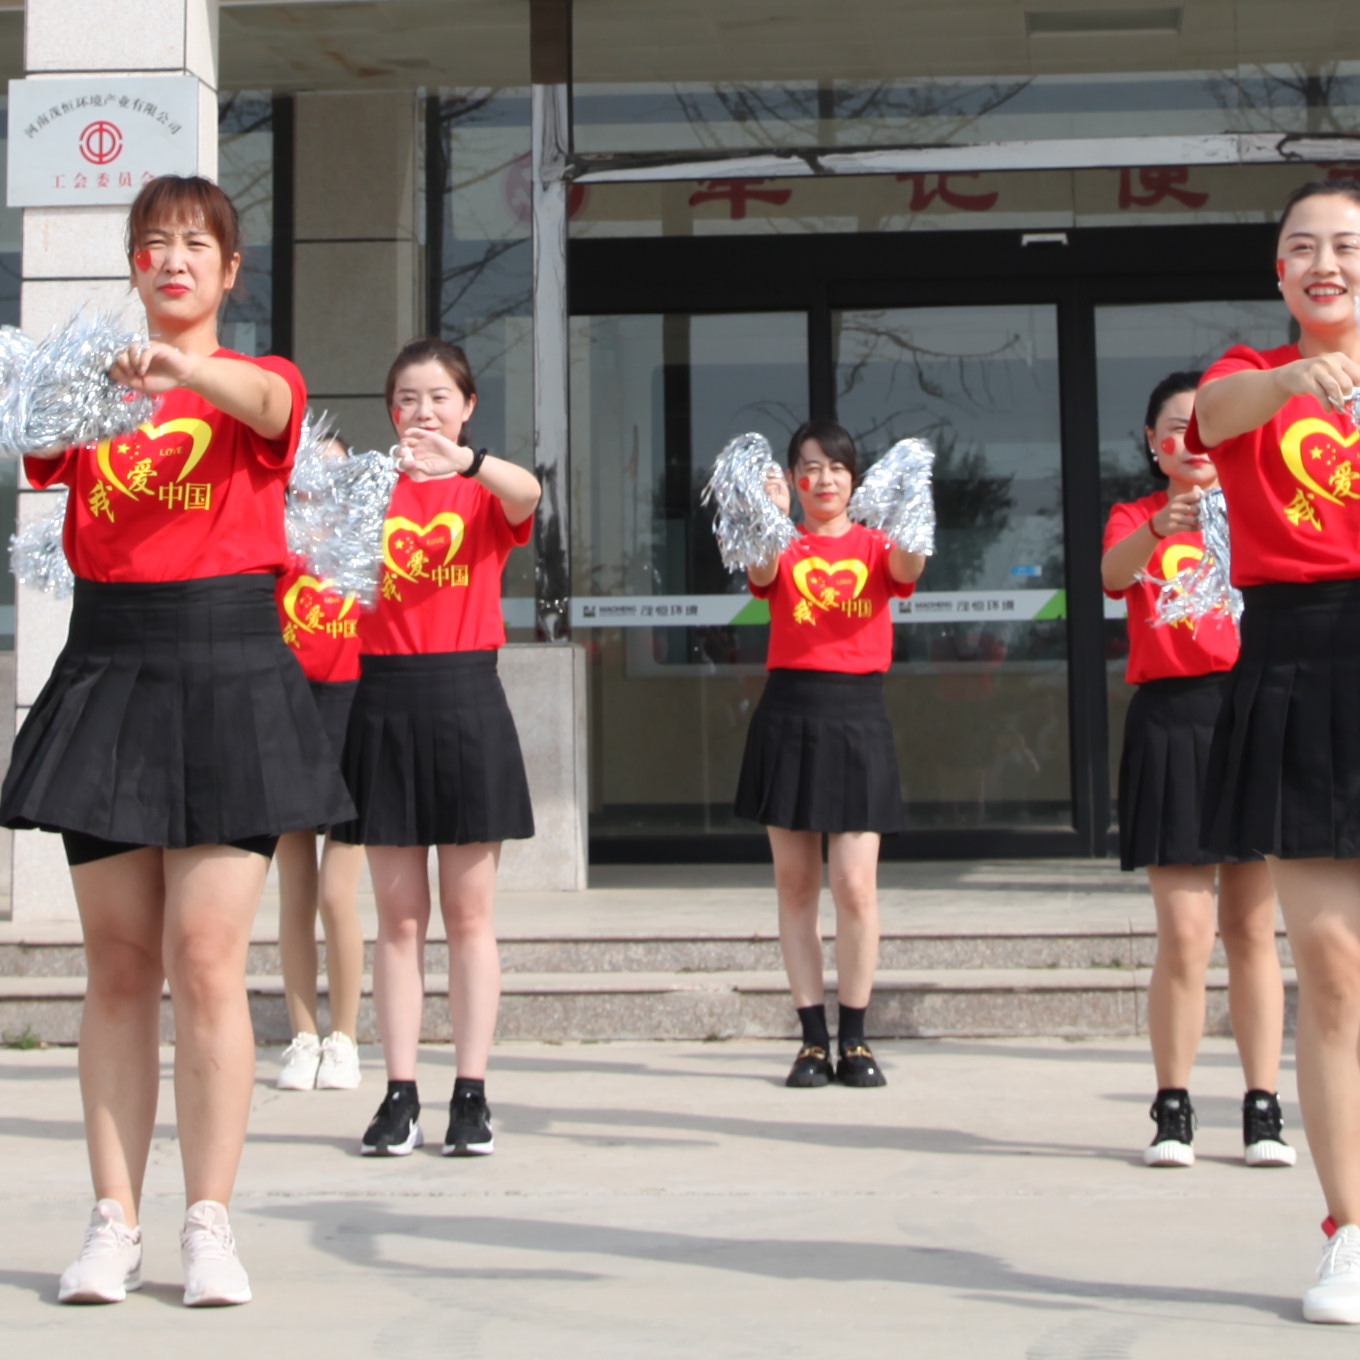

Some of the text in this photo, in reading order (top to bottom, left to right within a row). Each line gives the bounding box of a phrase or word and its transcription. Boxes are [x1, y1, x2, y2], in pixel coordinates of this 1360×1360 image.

[23, 93, 183, 139] 河南茂恒环境产业有限公司
[159, 445, 183, 457] LOVE
